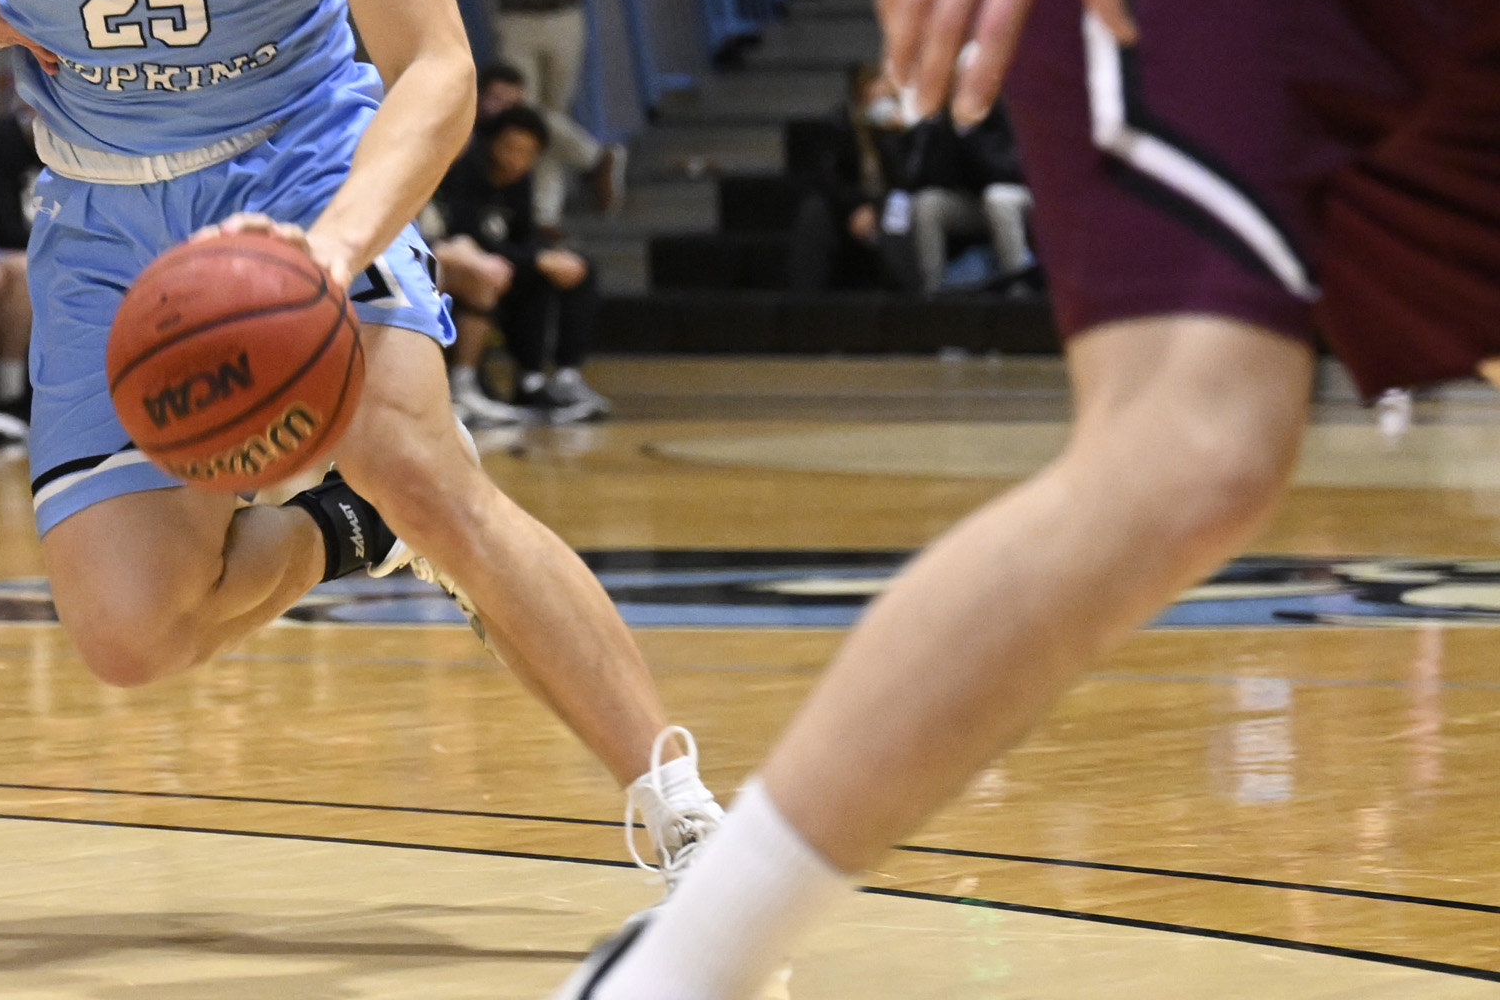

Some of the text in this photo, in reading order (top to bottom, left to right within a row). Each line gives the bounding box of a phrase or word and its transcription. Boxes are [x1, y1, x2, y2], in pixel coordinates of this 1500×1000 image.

[56, 41, 279, 92] OPKINS
[142, 349, 256, 428] NCAA
[337, 502, 365, 559] ZAMST
